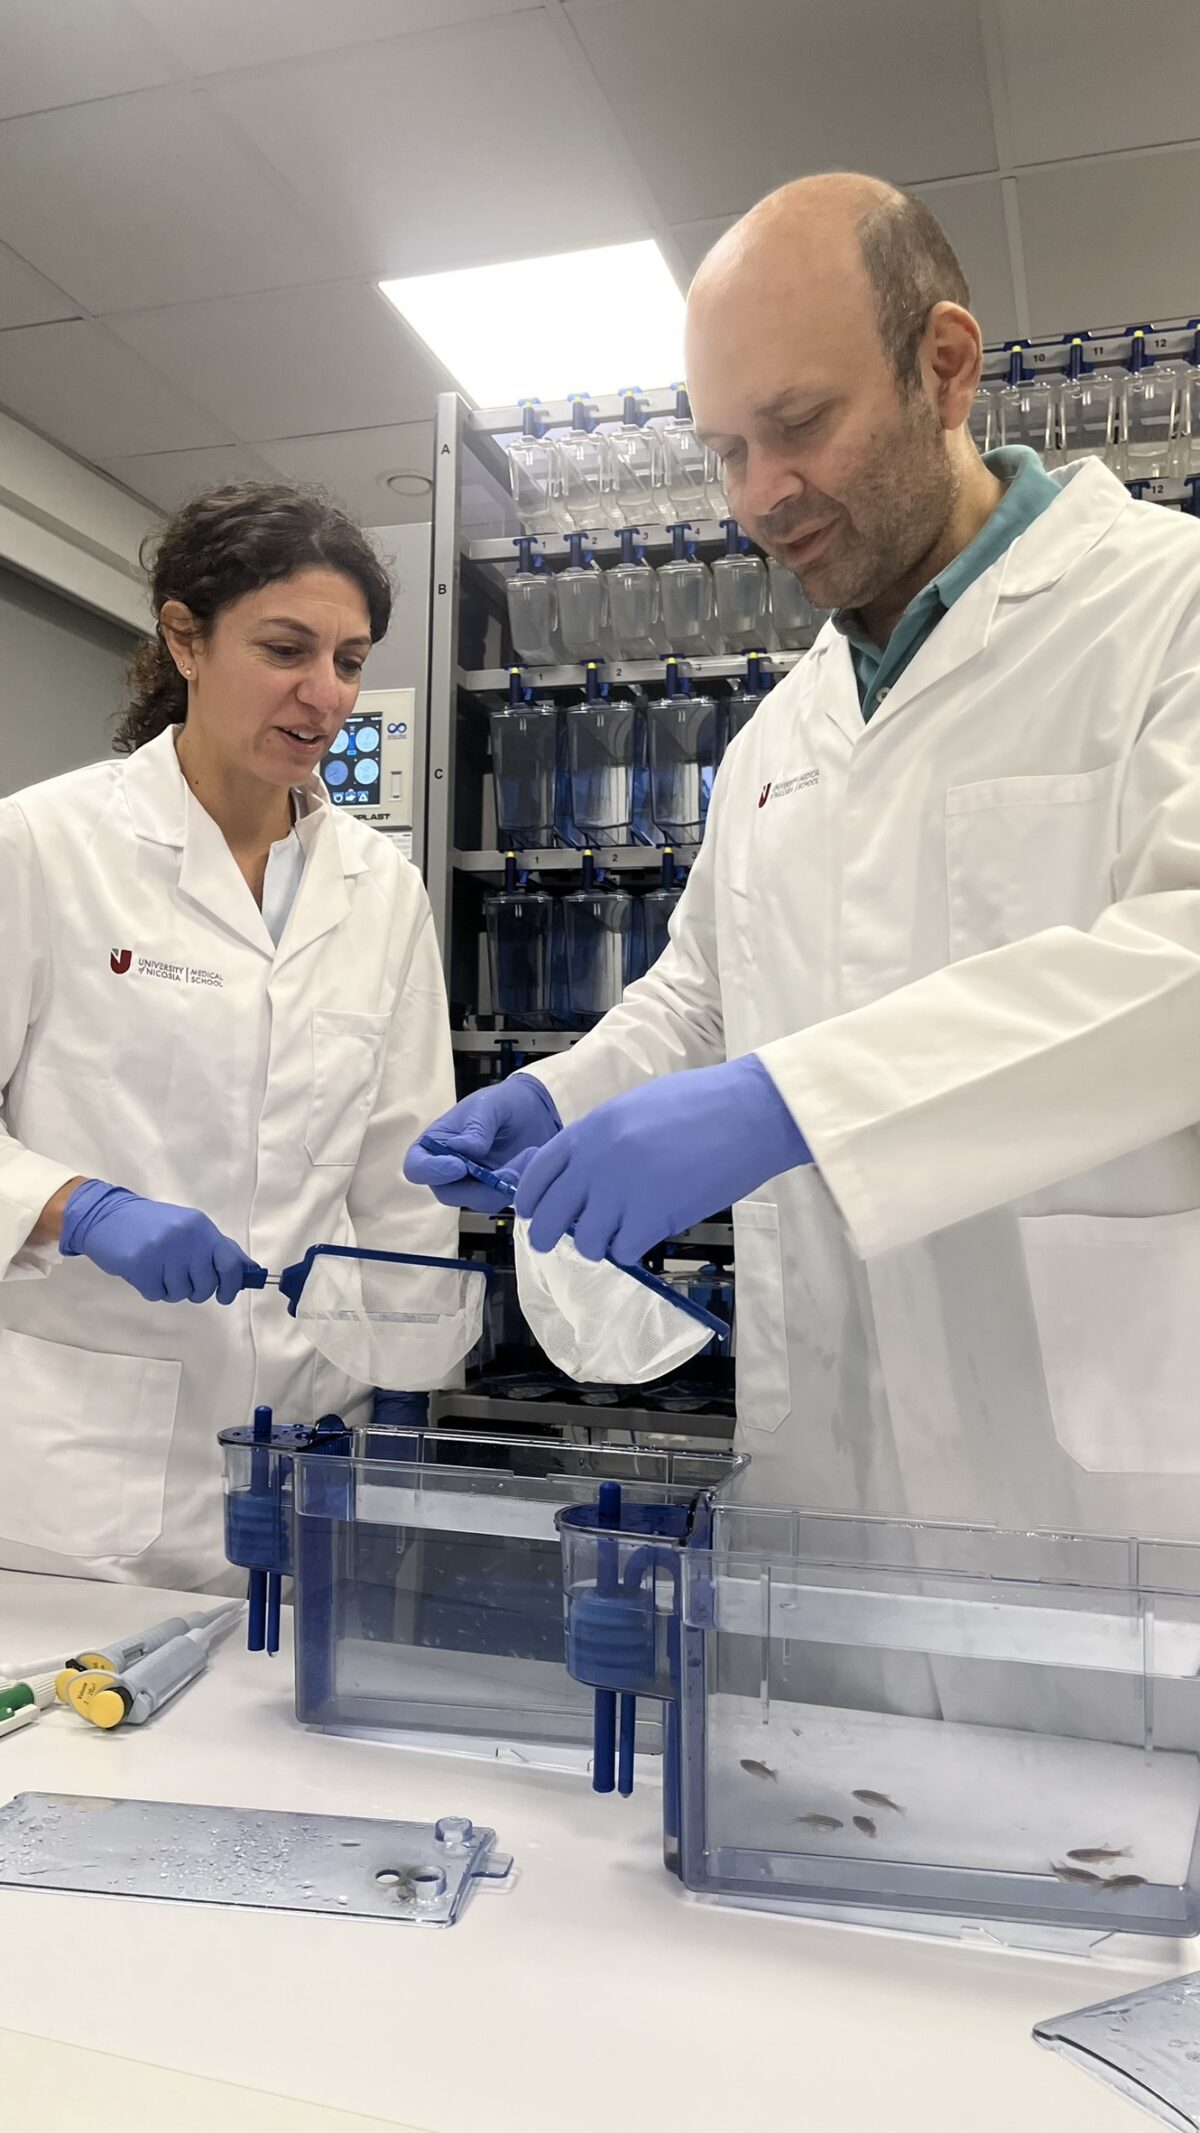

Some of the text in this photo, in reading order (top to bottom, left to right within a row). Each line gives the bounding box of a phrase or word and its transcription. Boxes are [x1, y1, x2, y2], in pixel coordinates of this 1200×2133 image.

[1154, 339, 1167, 348] 12
[1093, 346, 1104, 355] 11
[1032, 353, 1046, 363] 10
[440, 443, 451, 455] A
[1151, 485, 1164, 494] 12
[694, 527, 701, 535] 4
[591, 536, 598, 545] 2
[642, 532, 649, 540] 3
[541, 541, 546, 549] 1
[437, 583, 447, 595] B
[616, 668, 622, 677] 2
[434, 767, 444, 780] C
[612, 854, 618, 862] 2
[138, 958, 184, 974] UNIVERSITY
[146, 967, 181, 982] NICOSIA
[190, 969, 223, 981] MEDICAL
[190, 976, 223, 988] SCHOOL
